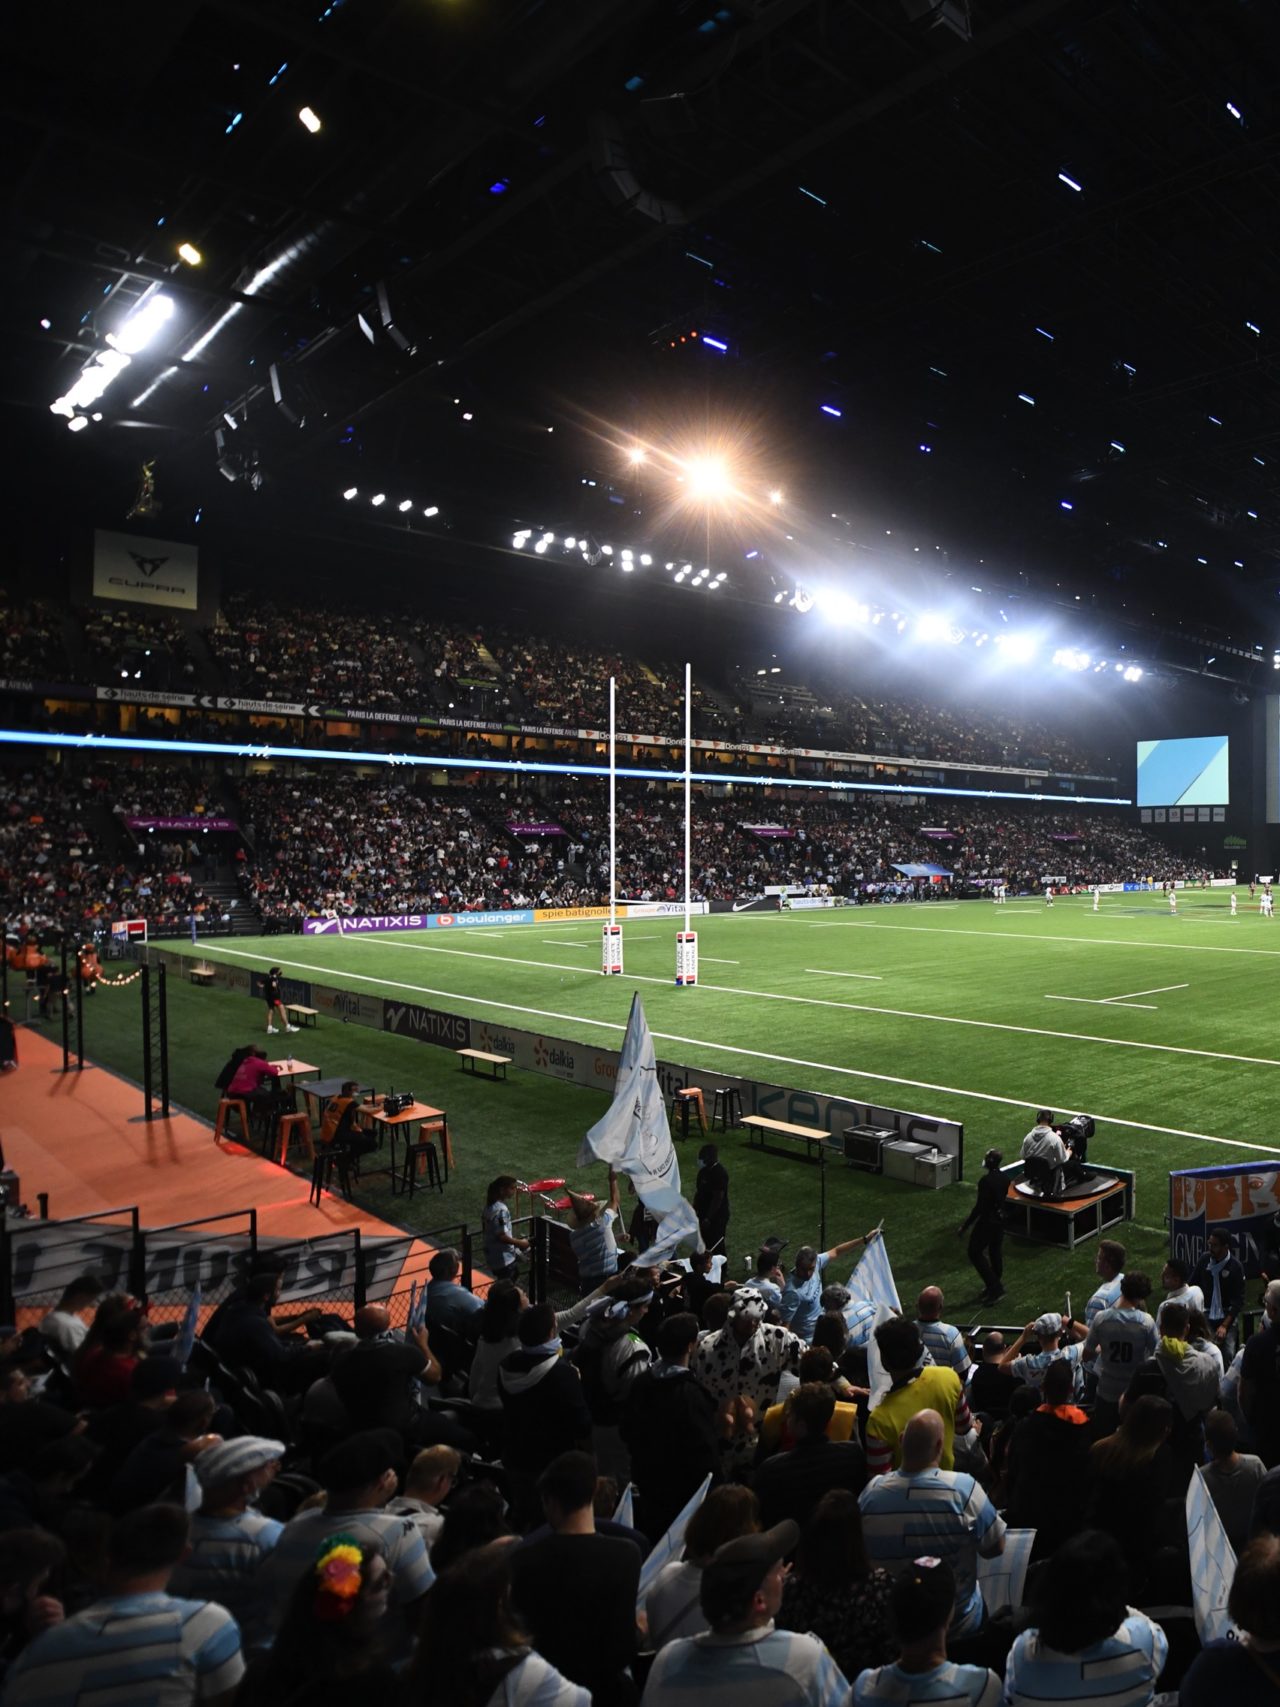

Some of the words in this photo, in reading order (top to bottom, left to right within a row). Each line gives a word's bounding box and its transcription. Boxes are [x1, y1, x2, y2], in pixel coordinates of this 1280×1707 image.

[108, 577, 186, 595] CUPRA
[347, 710, 366, 719] PARIS
[366, 711, 374, 720] LA
[374, 711, 400, 722] DEFENSE
[401, 713, 418, 723] ARENA
[439, 718, 456, 727] PARIS
[456, 719, 463, 727] LA
[463, 720, 487, 729] DEFENSE
[487, 721, 502, 730] ARENA
[521, 725, 536, 733] PARIS
[543, 727, 564, 736] DEFENSE
[600, 731, 628, 741] Doitos
[456, 912, 526, 926] boulanger
[542, 908, 564, 919] spie
[343, 915, 422, 929] NATIXIS
[339, 995, 360, 1017] Vital
[408, 1006, 466, 1043] NATIXIS
[493, 1037, 515, 1054] dalkia
[549, 1050, 575, 1070] dalkia
[1109, 1341, 1132, 1363] 20
